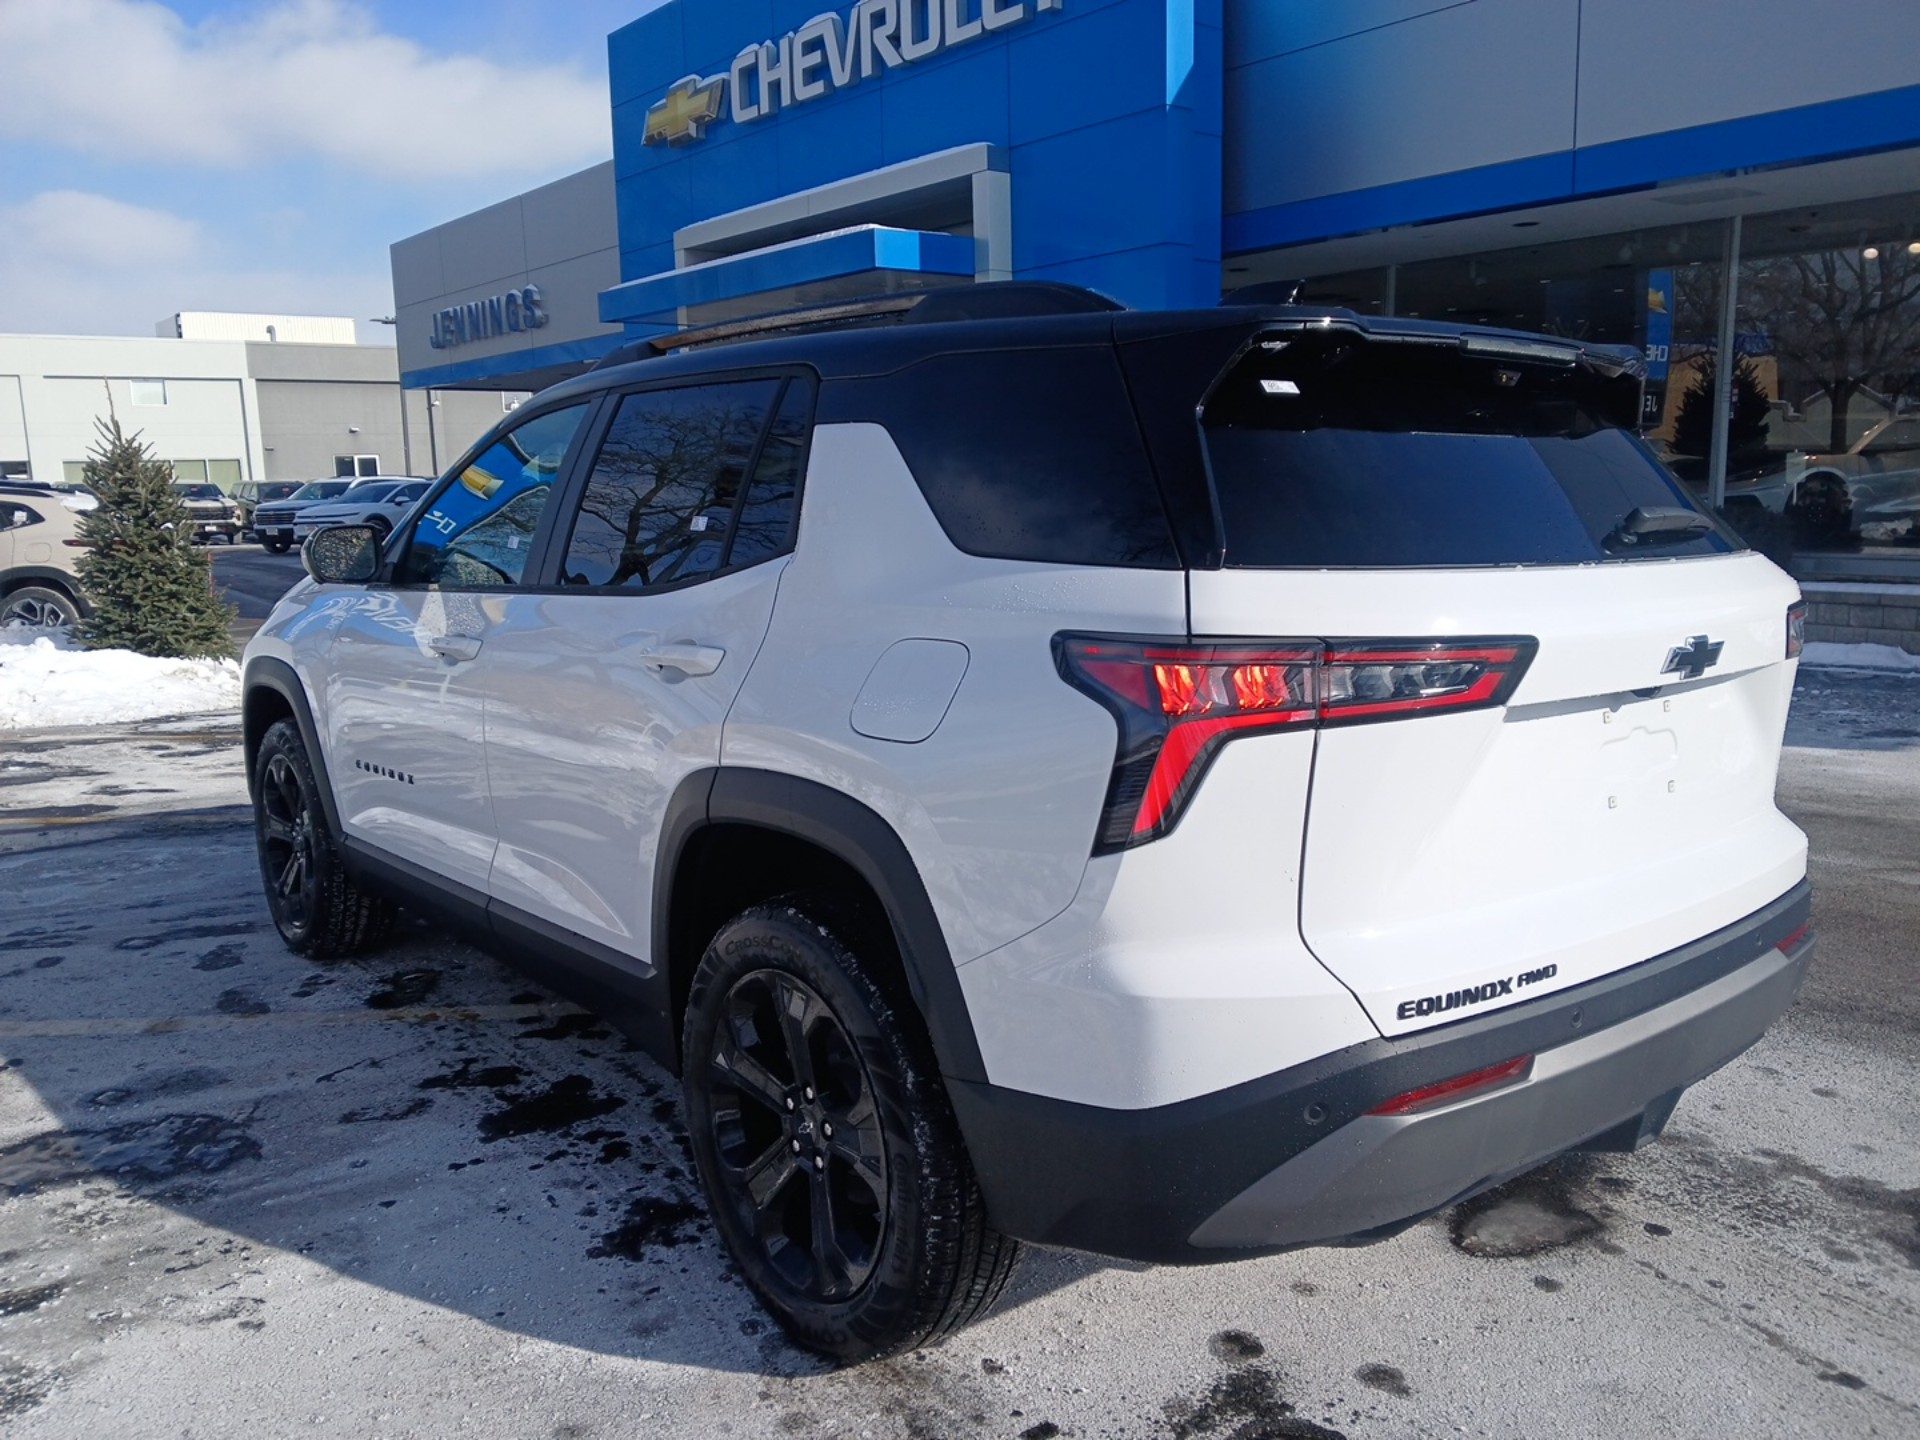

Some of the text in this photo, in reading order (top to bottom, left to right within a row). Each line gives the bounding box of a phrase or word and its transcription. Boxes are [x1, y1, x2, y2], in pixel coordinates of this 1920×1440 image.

[731, 0, 1060, 123] CHEVROL
[430, 284, 545, 348] JENNINGS
[1397, 963, 1557, 1020] EQUINOX AWD
